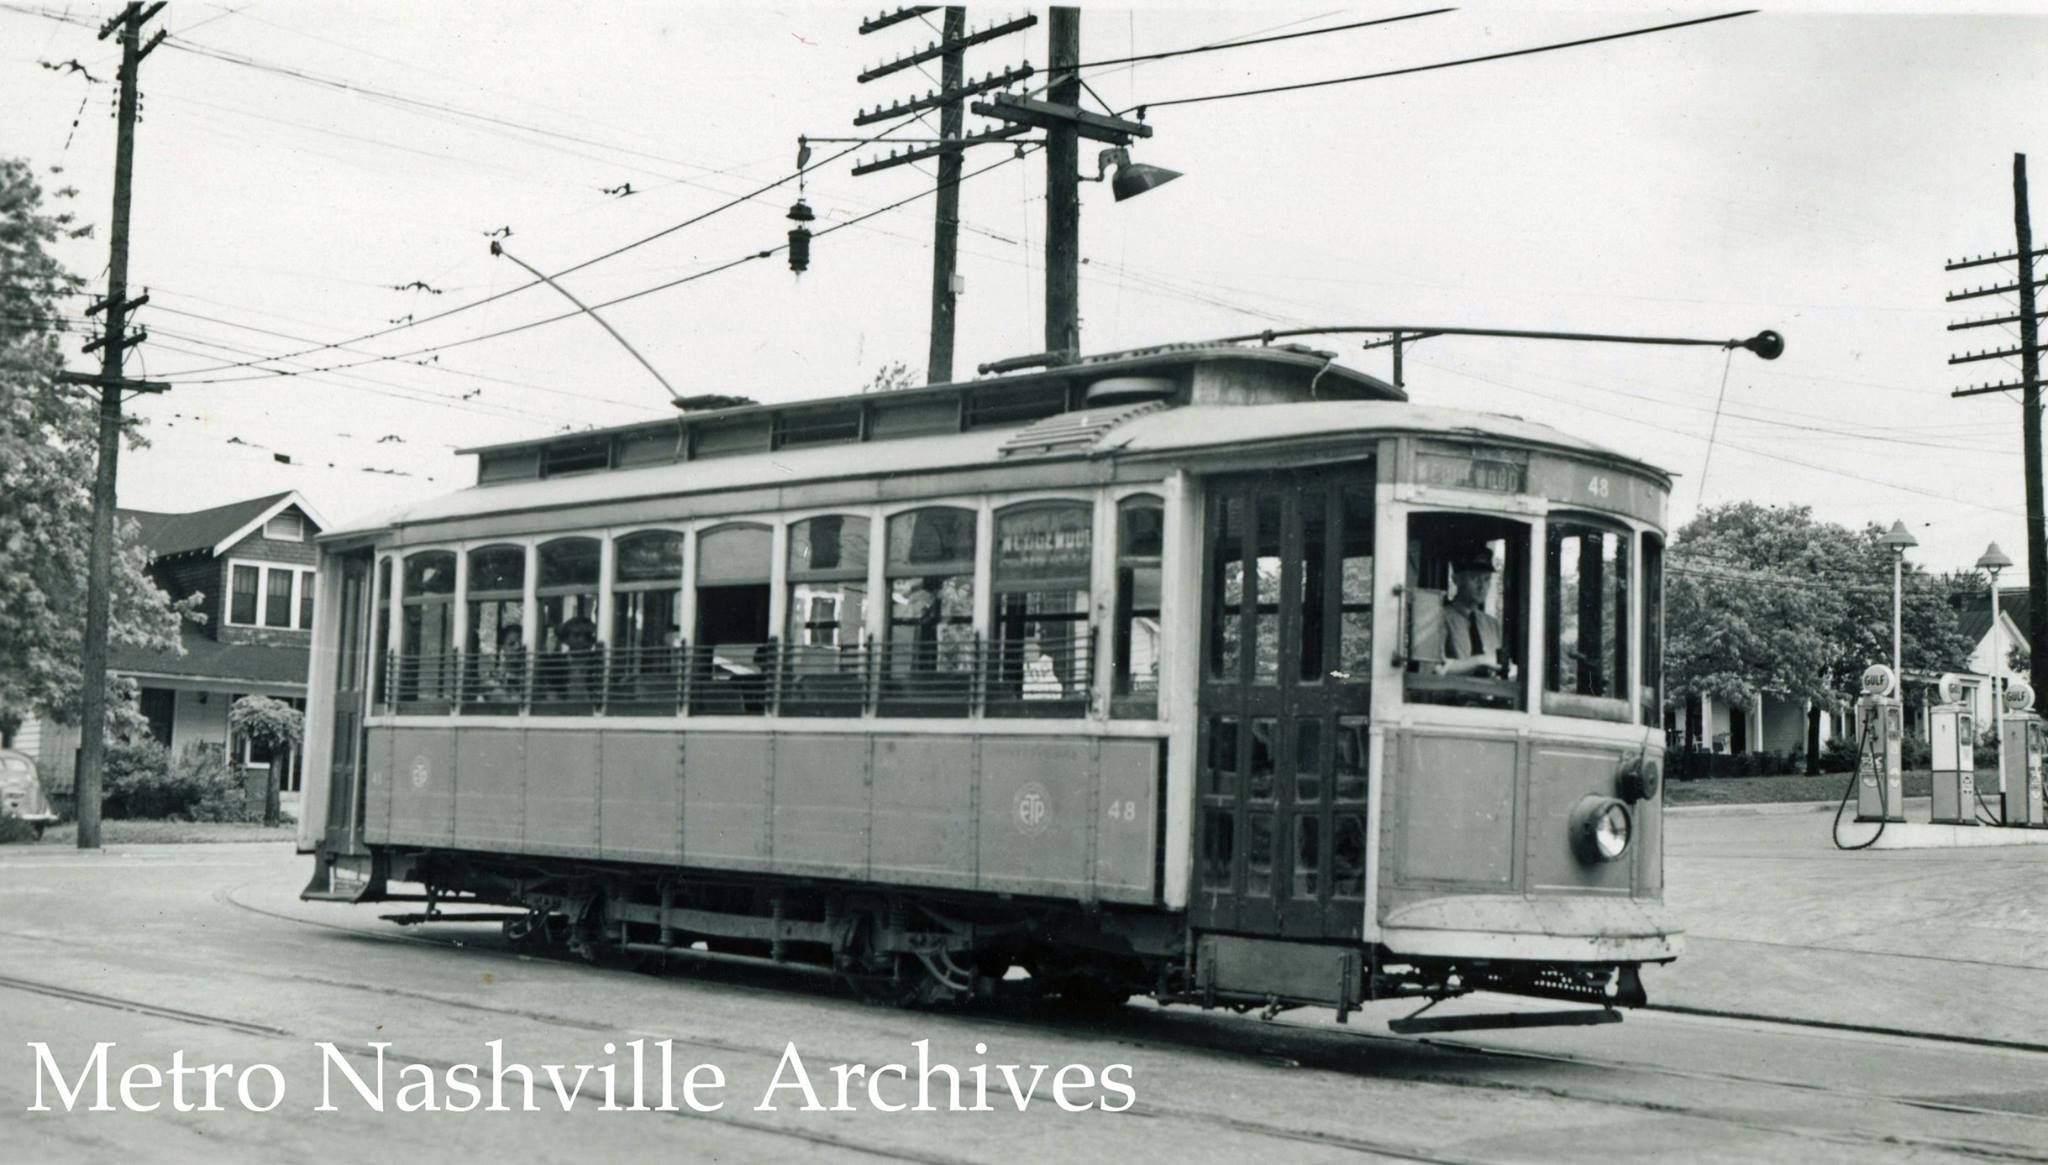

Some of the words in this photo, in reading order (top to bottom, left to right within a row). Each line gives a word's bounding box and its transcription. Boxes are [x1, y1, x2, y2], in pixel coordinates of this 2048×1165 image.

[1588, 476, 1609, 498] 48
[1864, 675, 1885, 686] GULF
[2006, 691, 2026, 702] GULF
[1107, 800, 1136, 821] 48
